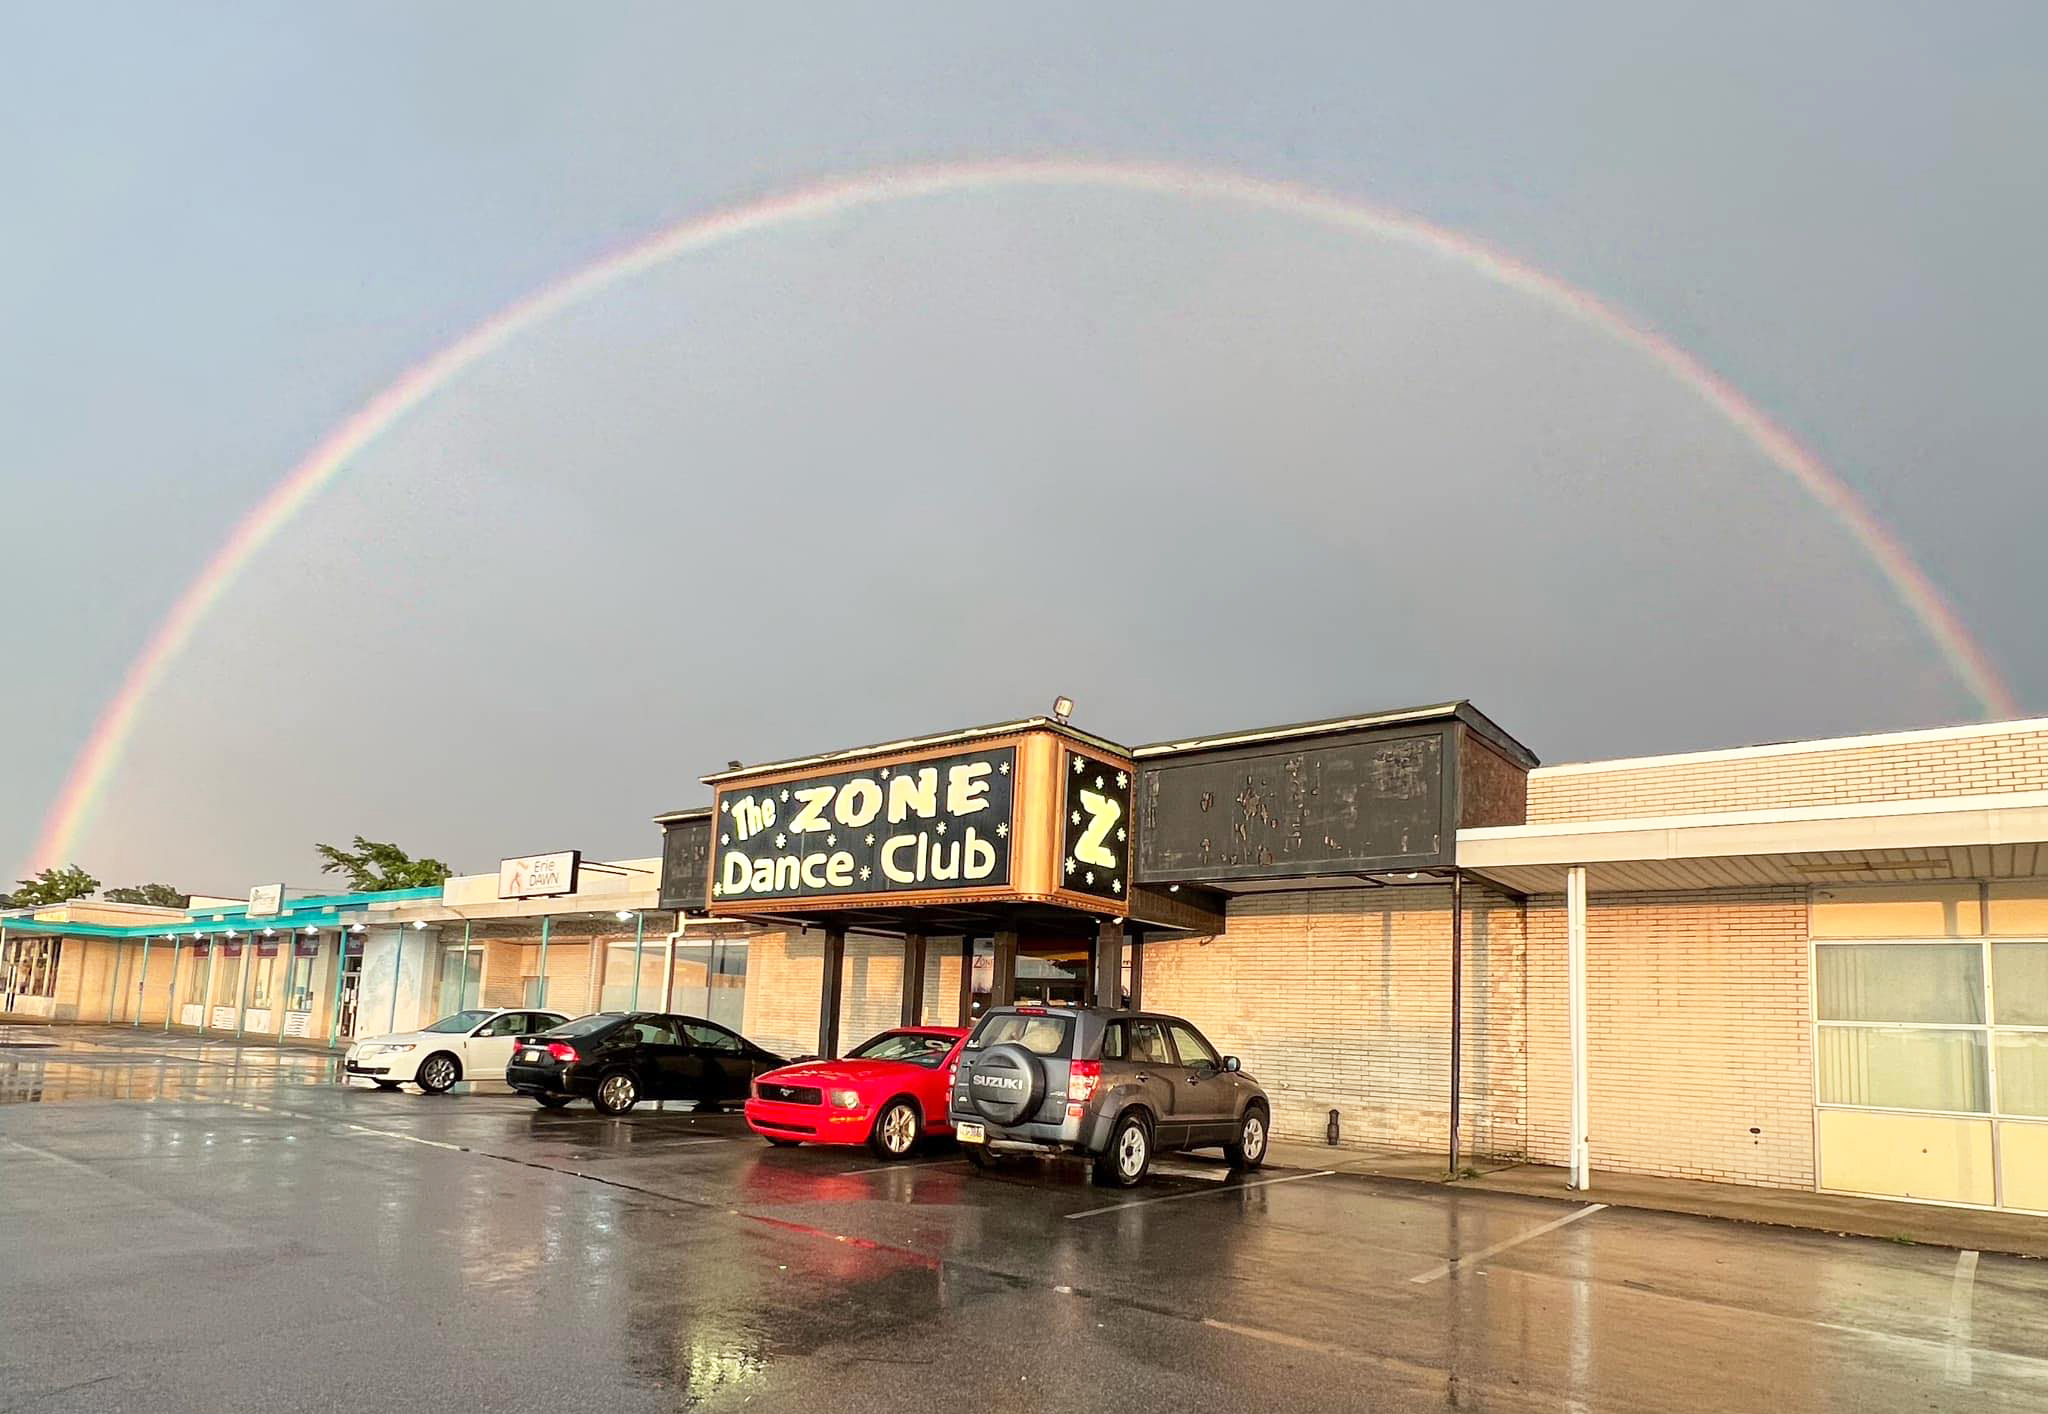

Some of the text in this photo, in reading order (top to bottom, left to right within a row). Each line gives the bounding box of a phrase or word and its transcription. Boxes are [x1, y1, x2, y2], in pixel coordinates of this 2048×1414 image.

[731, 761, 993, 841] The ZONE
[1074, 789, 1121, 869] Z
[529, 872, 559, 886] DAWN
[534, 860, 555, 872] Erie
[722, 826, 997, 895] Dance Club
[973, 1074, 1023, 1090] SUZUKI
